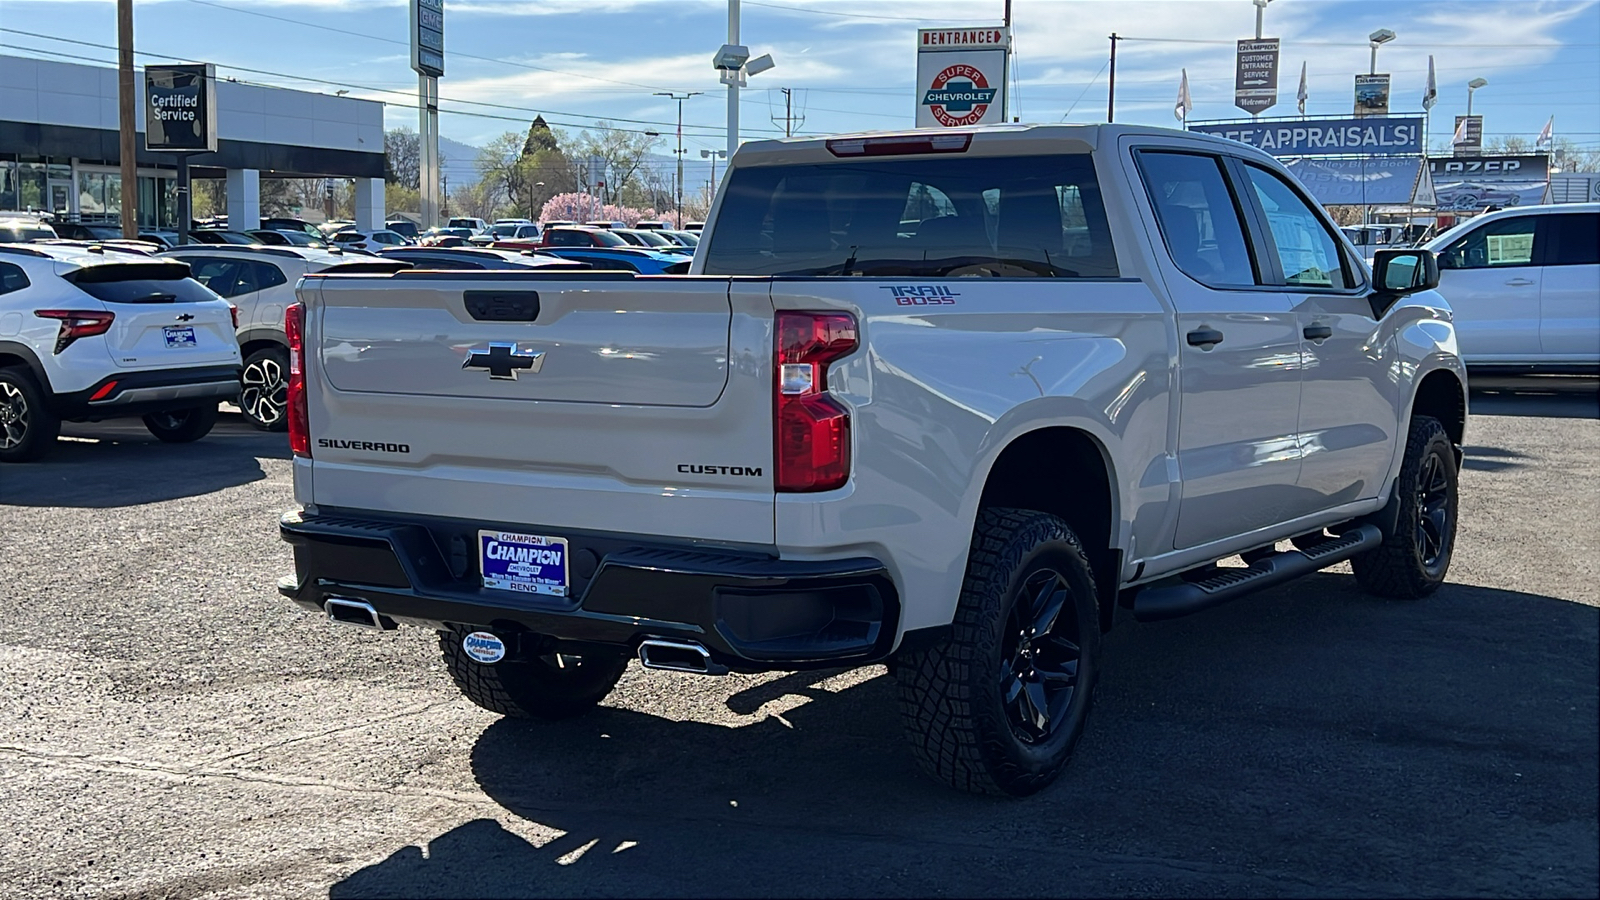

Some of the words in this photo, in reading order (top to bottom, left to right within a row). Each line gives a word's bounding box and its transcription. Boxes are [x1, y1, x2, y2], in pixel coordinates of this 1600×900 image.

[421, 10, 442, 29] GMC
[931, 31, 993, 45] ENTRANCE
[938, 66, 981, 82] SUPER
[151, 94, 198, 107] Certified
[927, 92, 991, 102] CHEVROLET
[154, 108, 195, 121] Service
[934, 107, 984, 127] SERVICE
[1260, 125, 1417, 150] APPRAISALS!
[1308, 160, 1346, 169] Kelley
[1349, 160, 1376, 168] Blue
[1380, 159, 1412, 168] Book
[879, 286, 961, 296] TRAIL
[895, 296, 956, 306] BOSS
[318, 438, 410, 454] SILVERADO
[677, 464, 763, 477] CUSTOM
[502, 533, 543, 545] CHAMPION
[486, 541, 562, 566] CHAMPION
[509, 564, 540, 574] CHEVROLET
[510, 582, 538, 593] RENO
